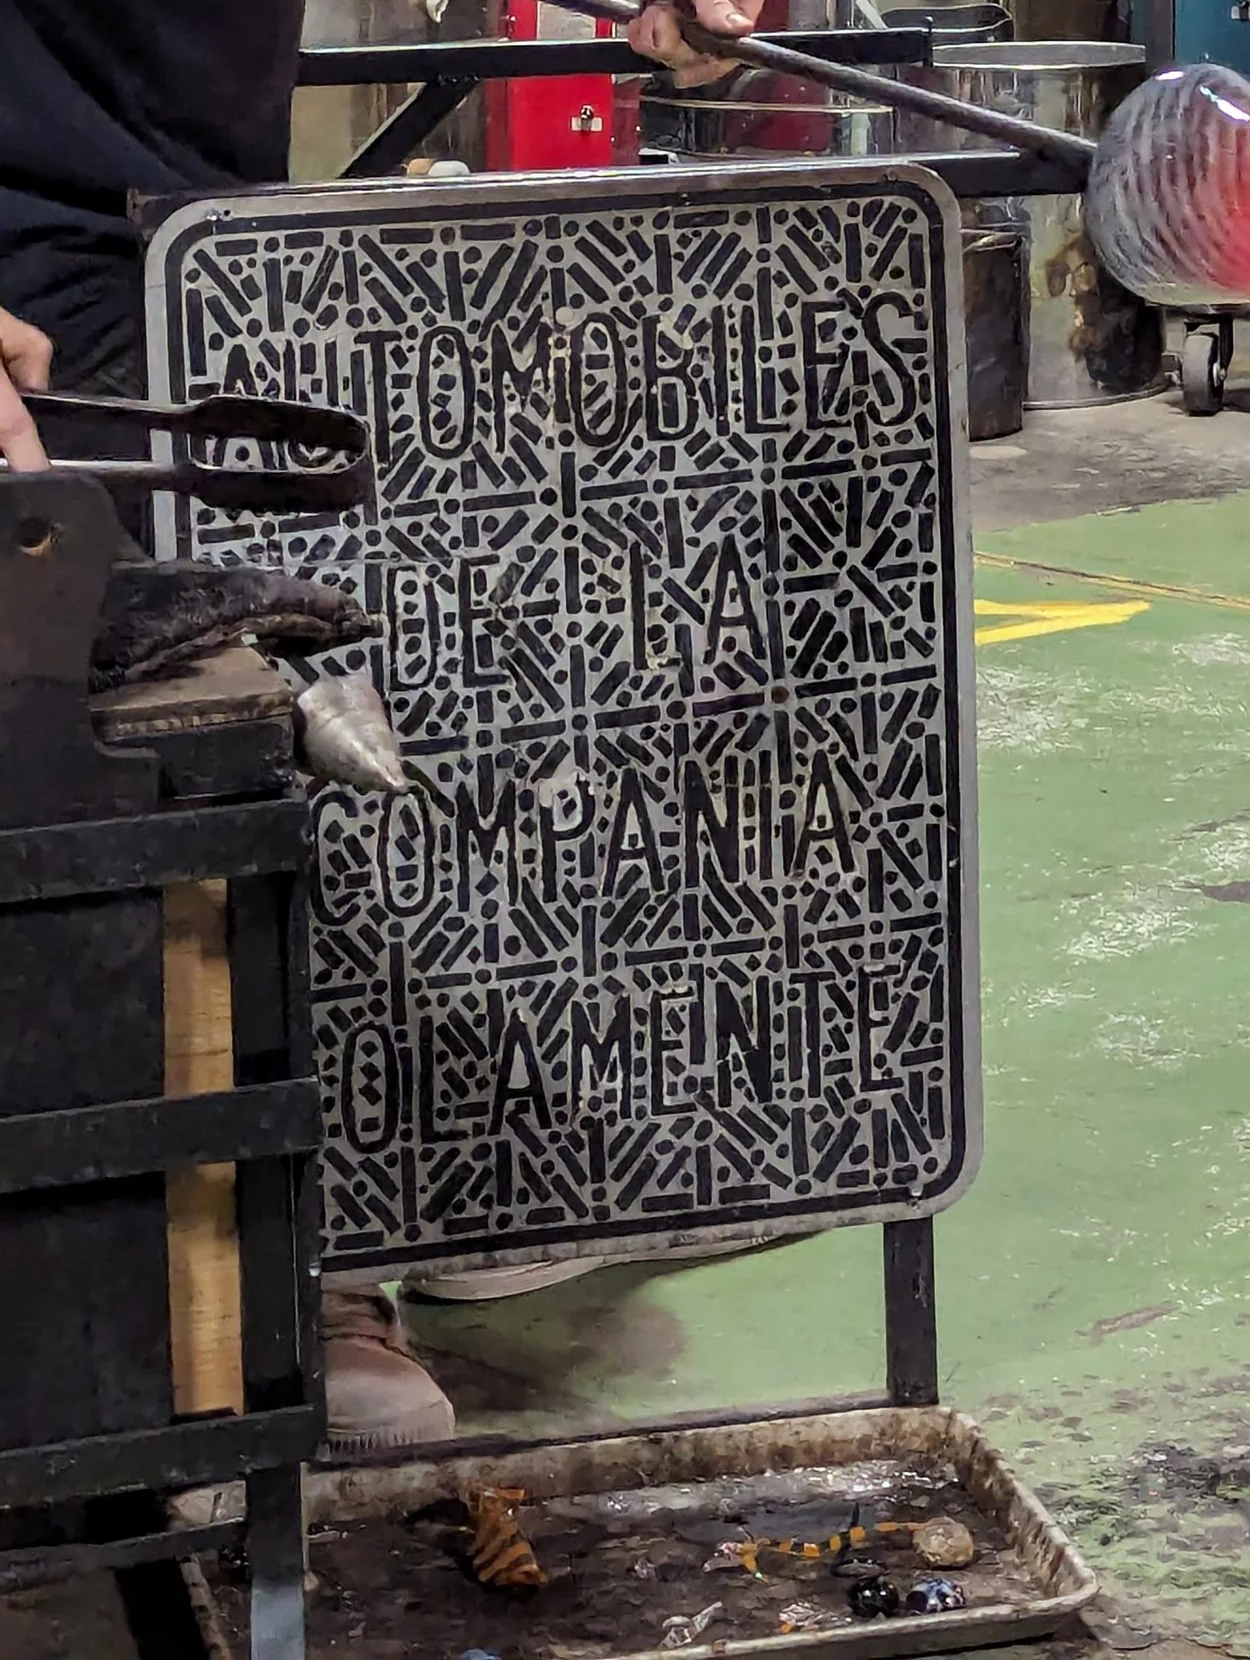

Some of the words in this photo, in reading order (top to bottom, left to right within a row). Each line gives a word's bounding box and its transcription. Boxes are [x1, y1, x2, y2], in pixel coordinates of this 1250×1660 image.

[386, 553, 510, 691] DE
[630, 534, 767, 670] LA
[310, 748, 855, 926] COMPANIA
[341, 963, 904, 1154] OLAMENTE
